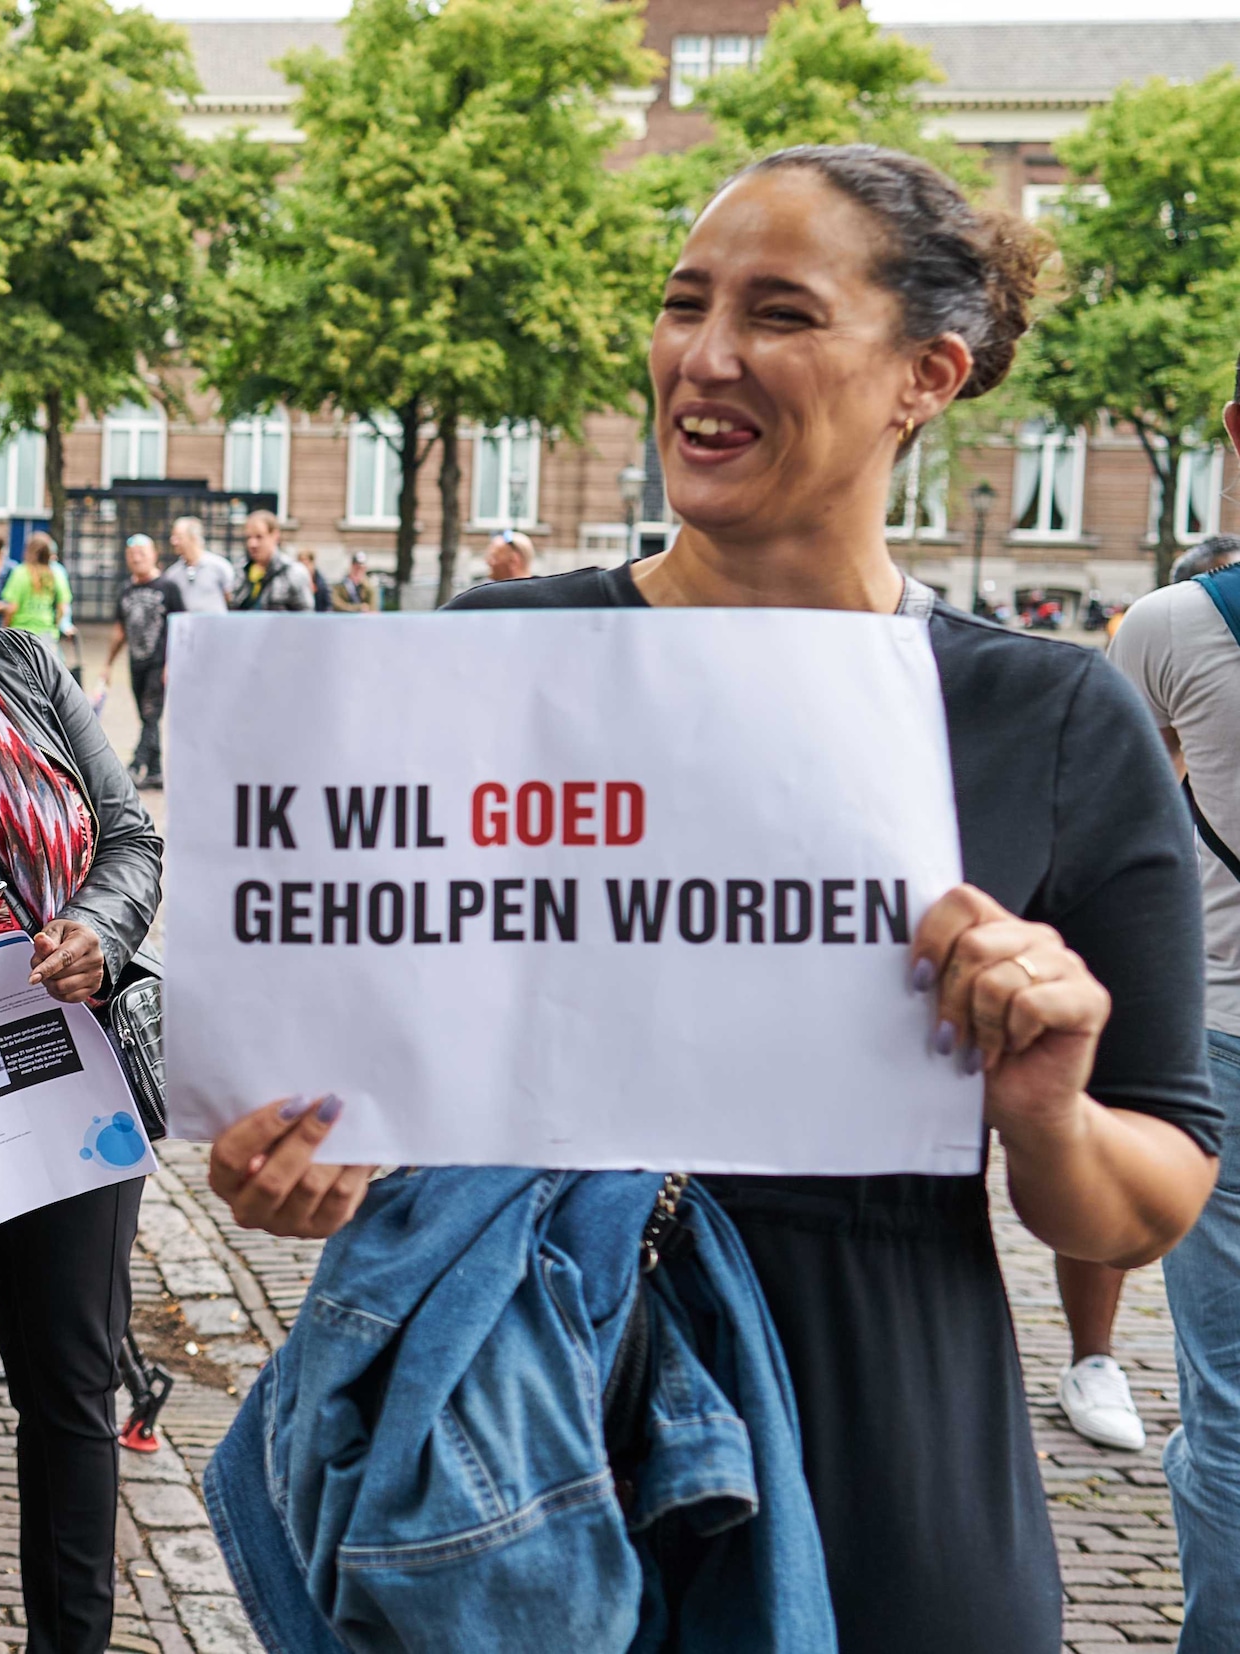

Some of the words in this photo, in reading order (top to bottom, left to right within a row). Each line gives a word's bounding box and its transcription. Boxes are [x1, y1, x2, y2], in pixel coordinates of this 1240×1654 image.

[235, 784, 298, 850] IK
[324, 785, 445, 849] WIL
[472, 781, 644, 846] GOED
[234, 879, 577, 945] GEHOLPEN
[605, 877, 910, 945] WORDEN
